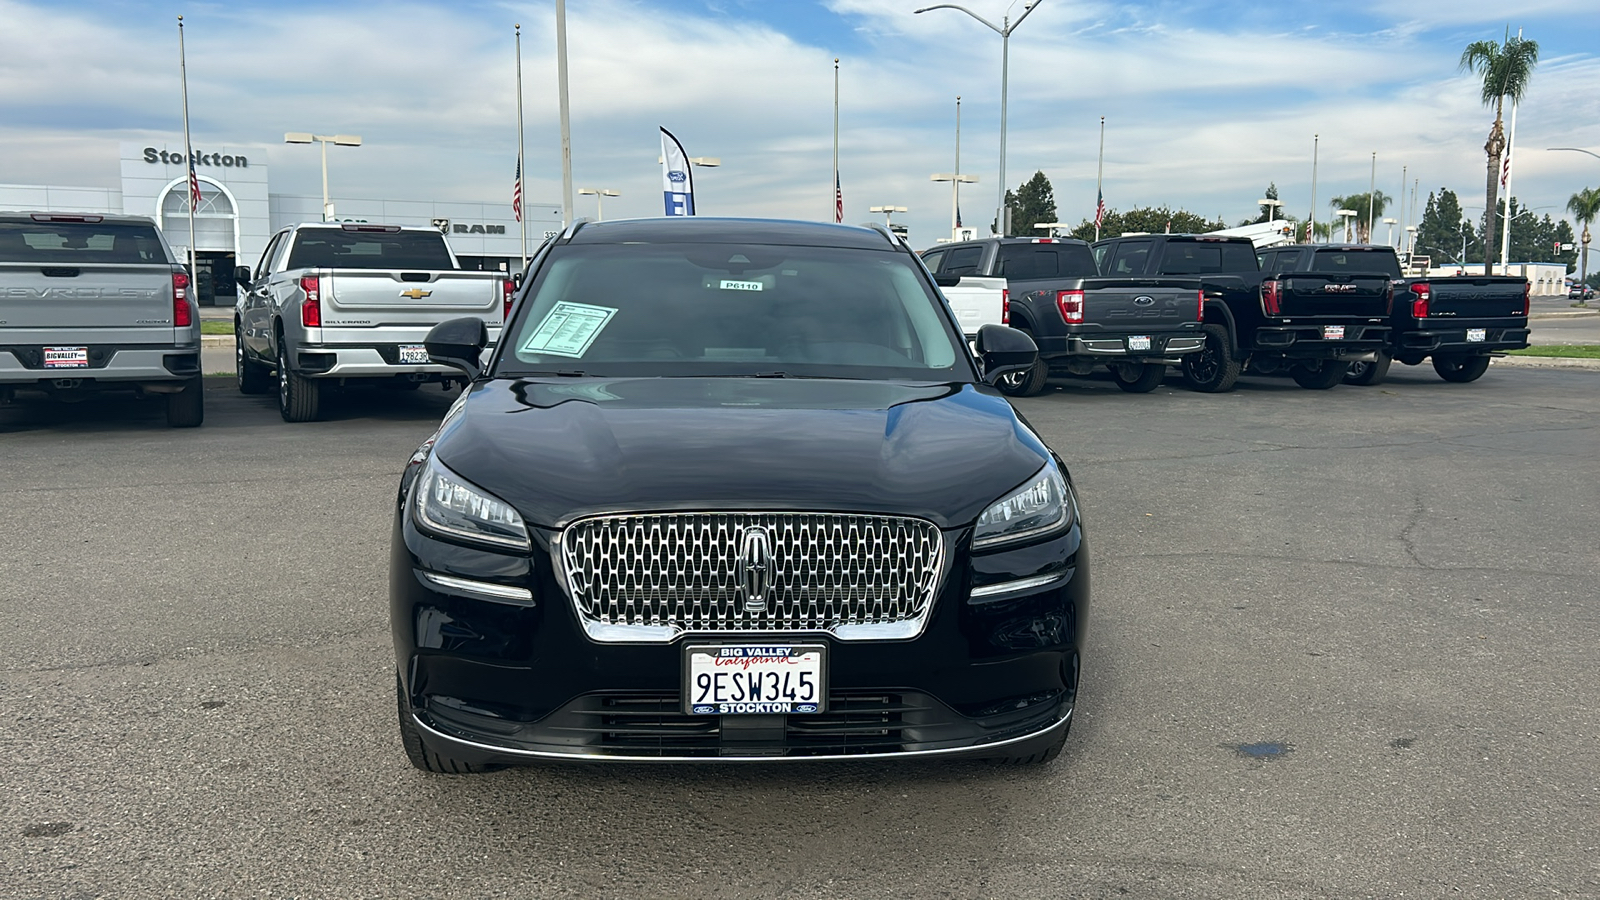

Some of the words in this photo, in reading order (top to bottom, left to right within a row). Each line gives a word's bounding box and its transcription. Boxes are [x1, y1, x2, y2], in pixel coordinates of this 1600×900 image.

[453, 224, 505, 235] RAM
[726, 282, 758, 290] P6110
[0, 287, 156, 299] EVROLET
[1105, 308, 1180, 318] F-150
[720, 648, 743, 657] BIG
[746, 648, 792, 657] VALLEY
[715, 656, 799, 670] California
[696, 671, 814, 703] 9ESW345
[719, 702, 792, 713] STOCKTON
